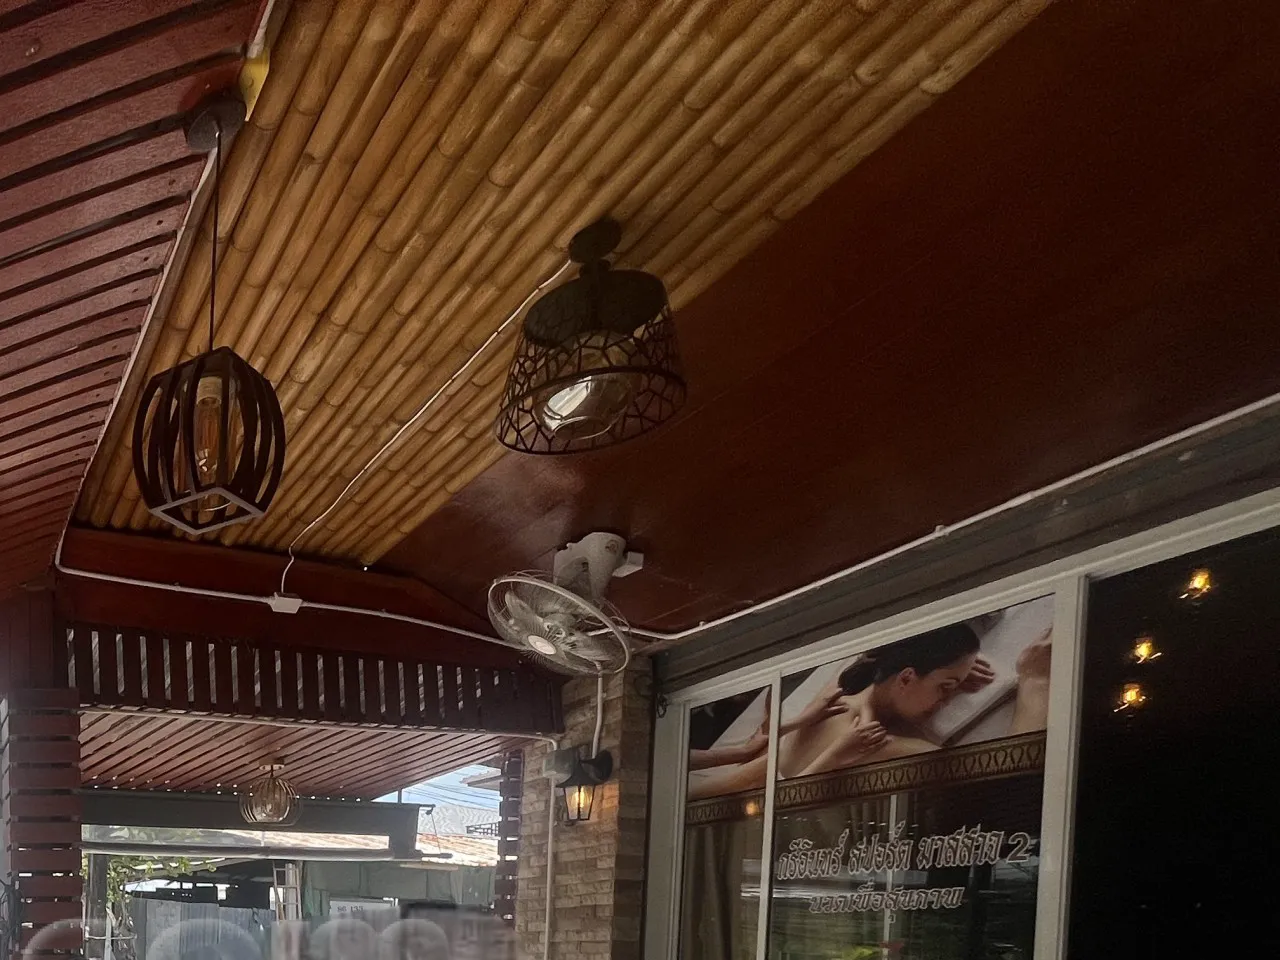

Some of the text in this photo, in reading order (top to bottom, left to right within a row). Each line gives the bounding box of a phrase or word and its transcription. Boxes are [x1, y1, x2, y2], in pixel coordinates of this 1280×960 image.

[1006, 832, 1031, 864] 2
[809, 877, 965, 924] นวดเพื่อสุขภาพ
